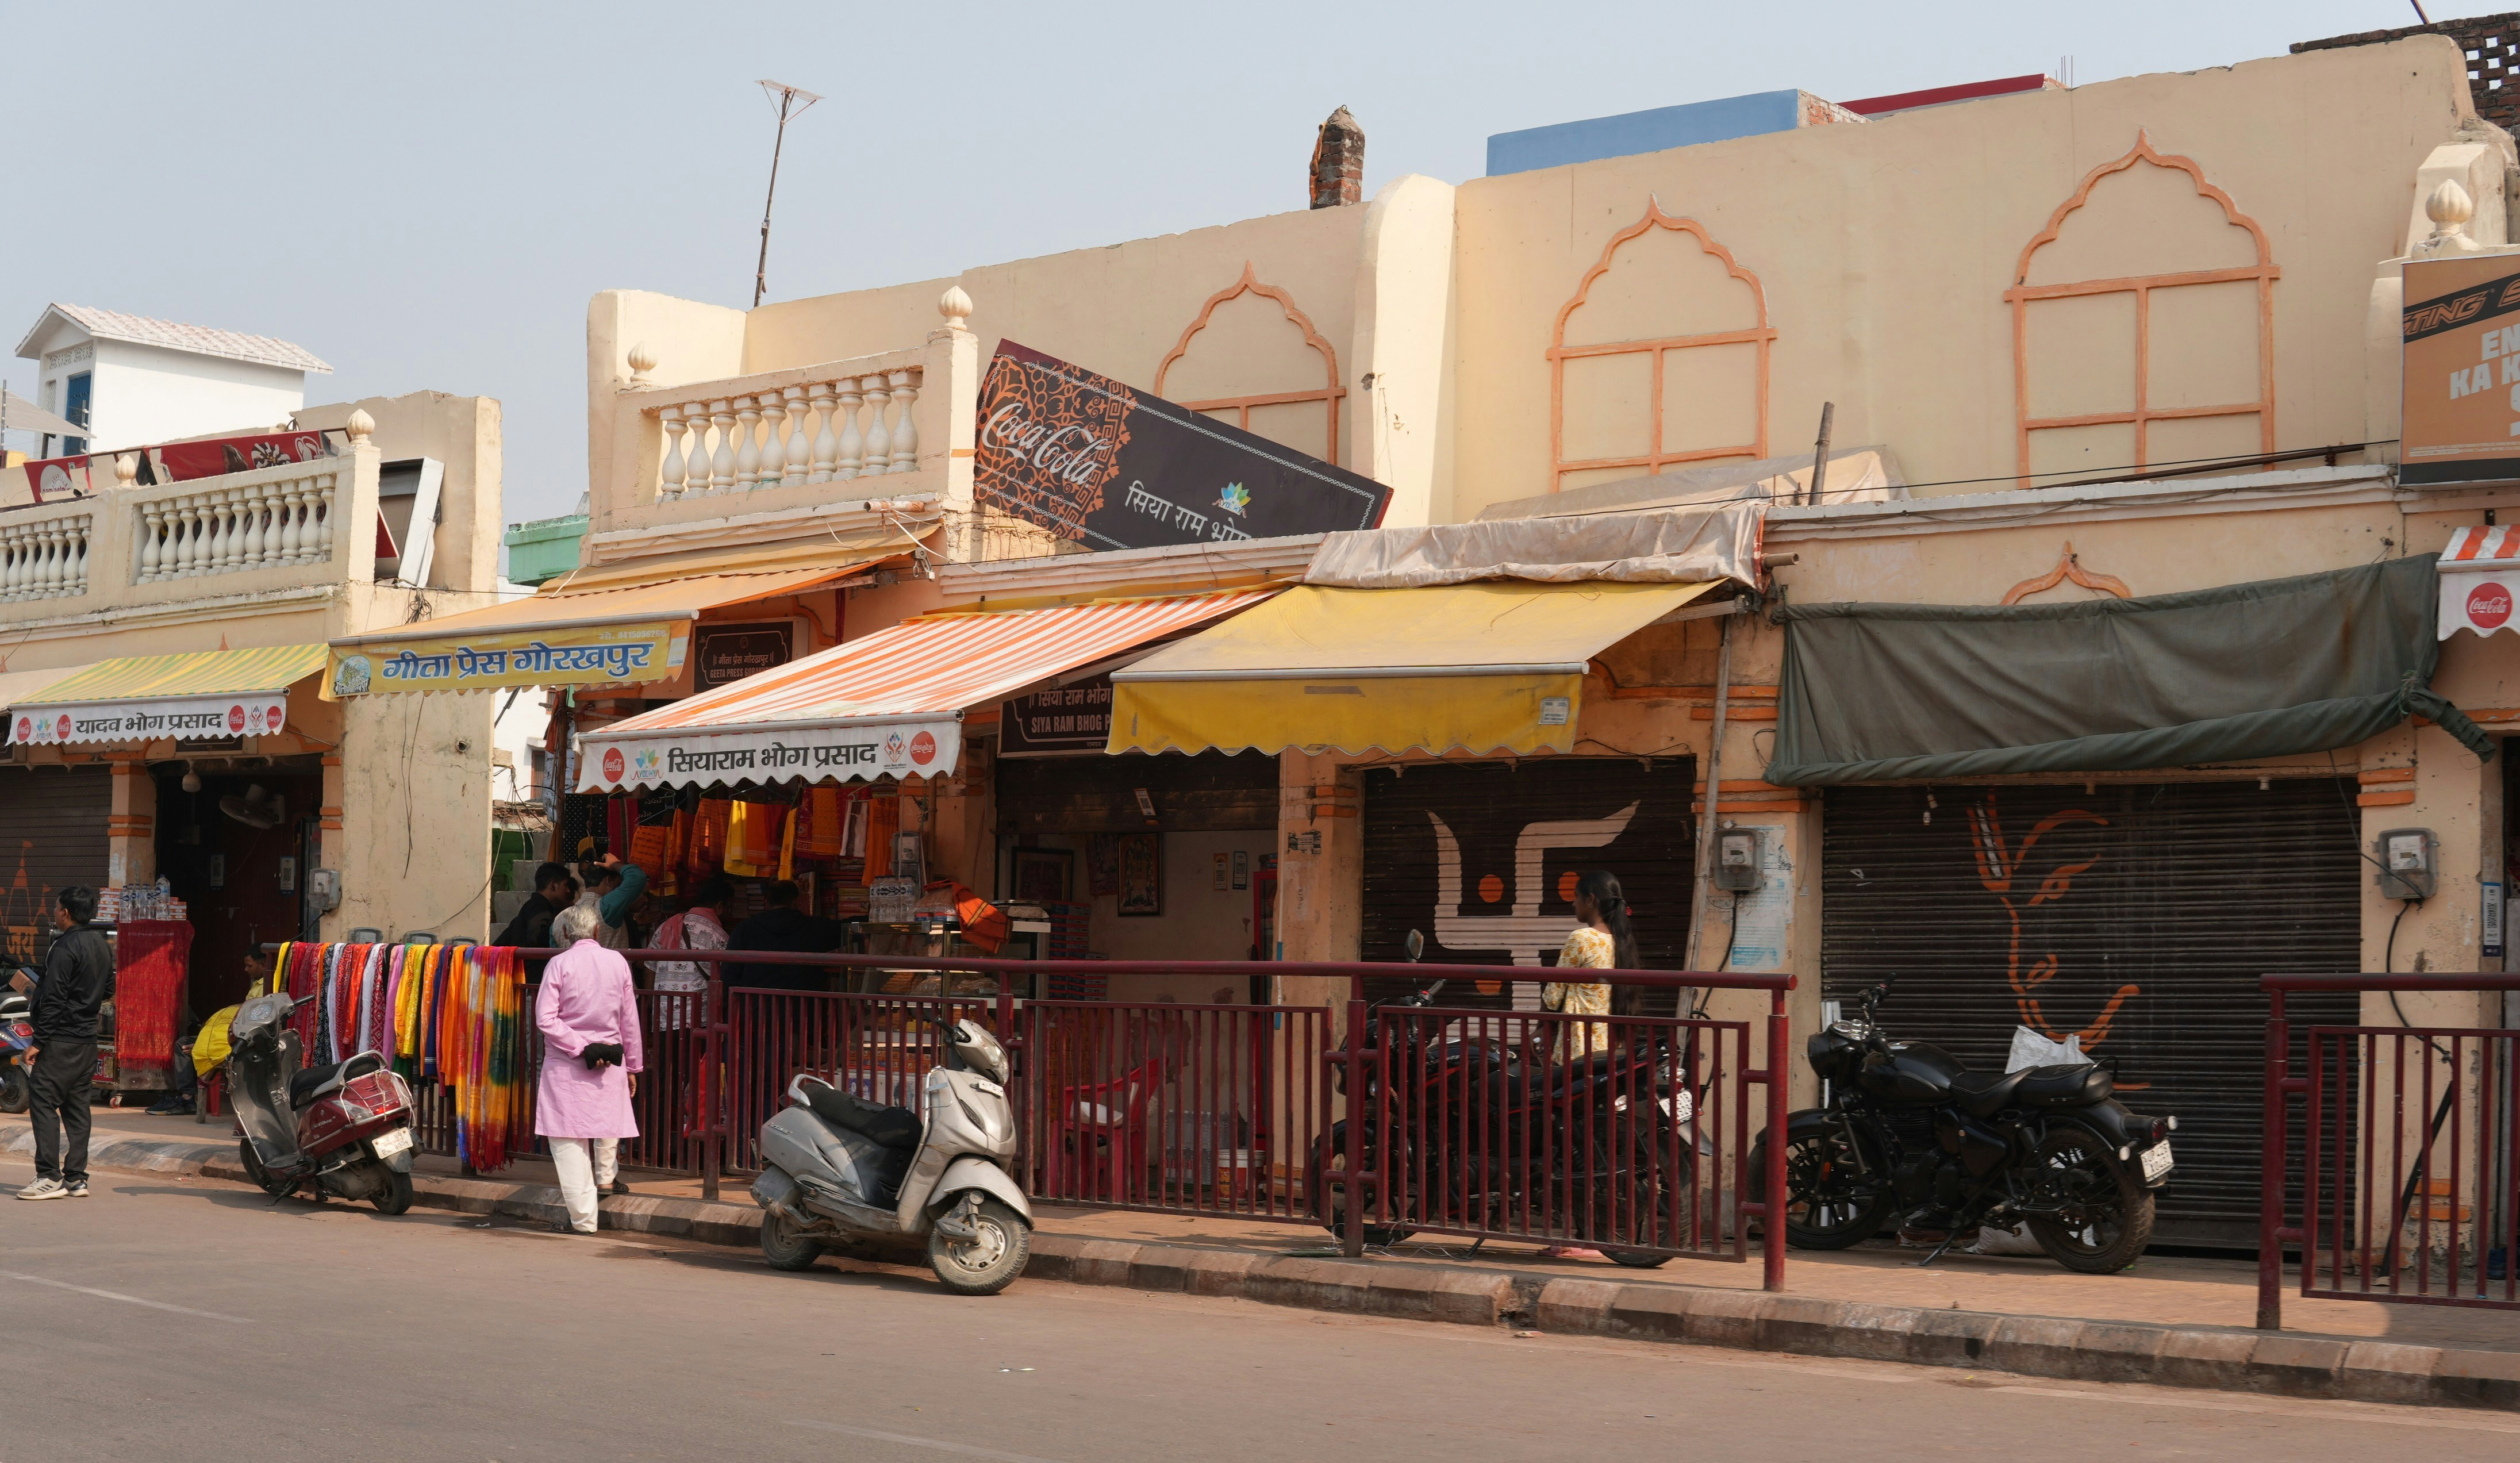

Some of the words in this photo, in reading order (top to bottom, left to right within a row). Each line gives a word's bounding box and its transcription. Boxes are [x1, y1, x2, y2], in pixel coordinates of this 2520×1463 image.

[2450, 363, 2492, 400] KA
[981, 402, 1114, 487] Coca-Cola
[1124, 480, 1174, 523] सिया
[1176, 506, 1208, 536] राम
[382, 650, 452, 681] गीता
[456, 646, 507, 679] प्रेस
[511, 640, 655, 678] गोरखपुर
[710, 669, 725, 678] GEETA
[727, 667, 743, 677] PRESS
[719, 654, 732, 664] गीता
[733, 654, 742, 665] प्रेस
[744, 652, 769, 666] गोरखपुर
[1065, 690, 1084, 705] राम
[76, 718, 122, 734] यादव
[125, 712, 165, 731] भोग
[168, 713, 224, 731] प्रसाद
[1032, 717, 1051, 733] SIYA
[1054, 716, 1074, 732] RAM
[1077, 714, 1101, 731] BHOG
[667, 747, 756, 773] सियाराम
[761, 742, 810, 767] भोग
[813, 743, 879, 768] प्रसाद
[7, 926, 39, 964] जय
